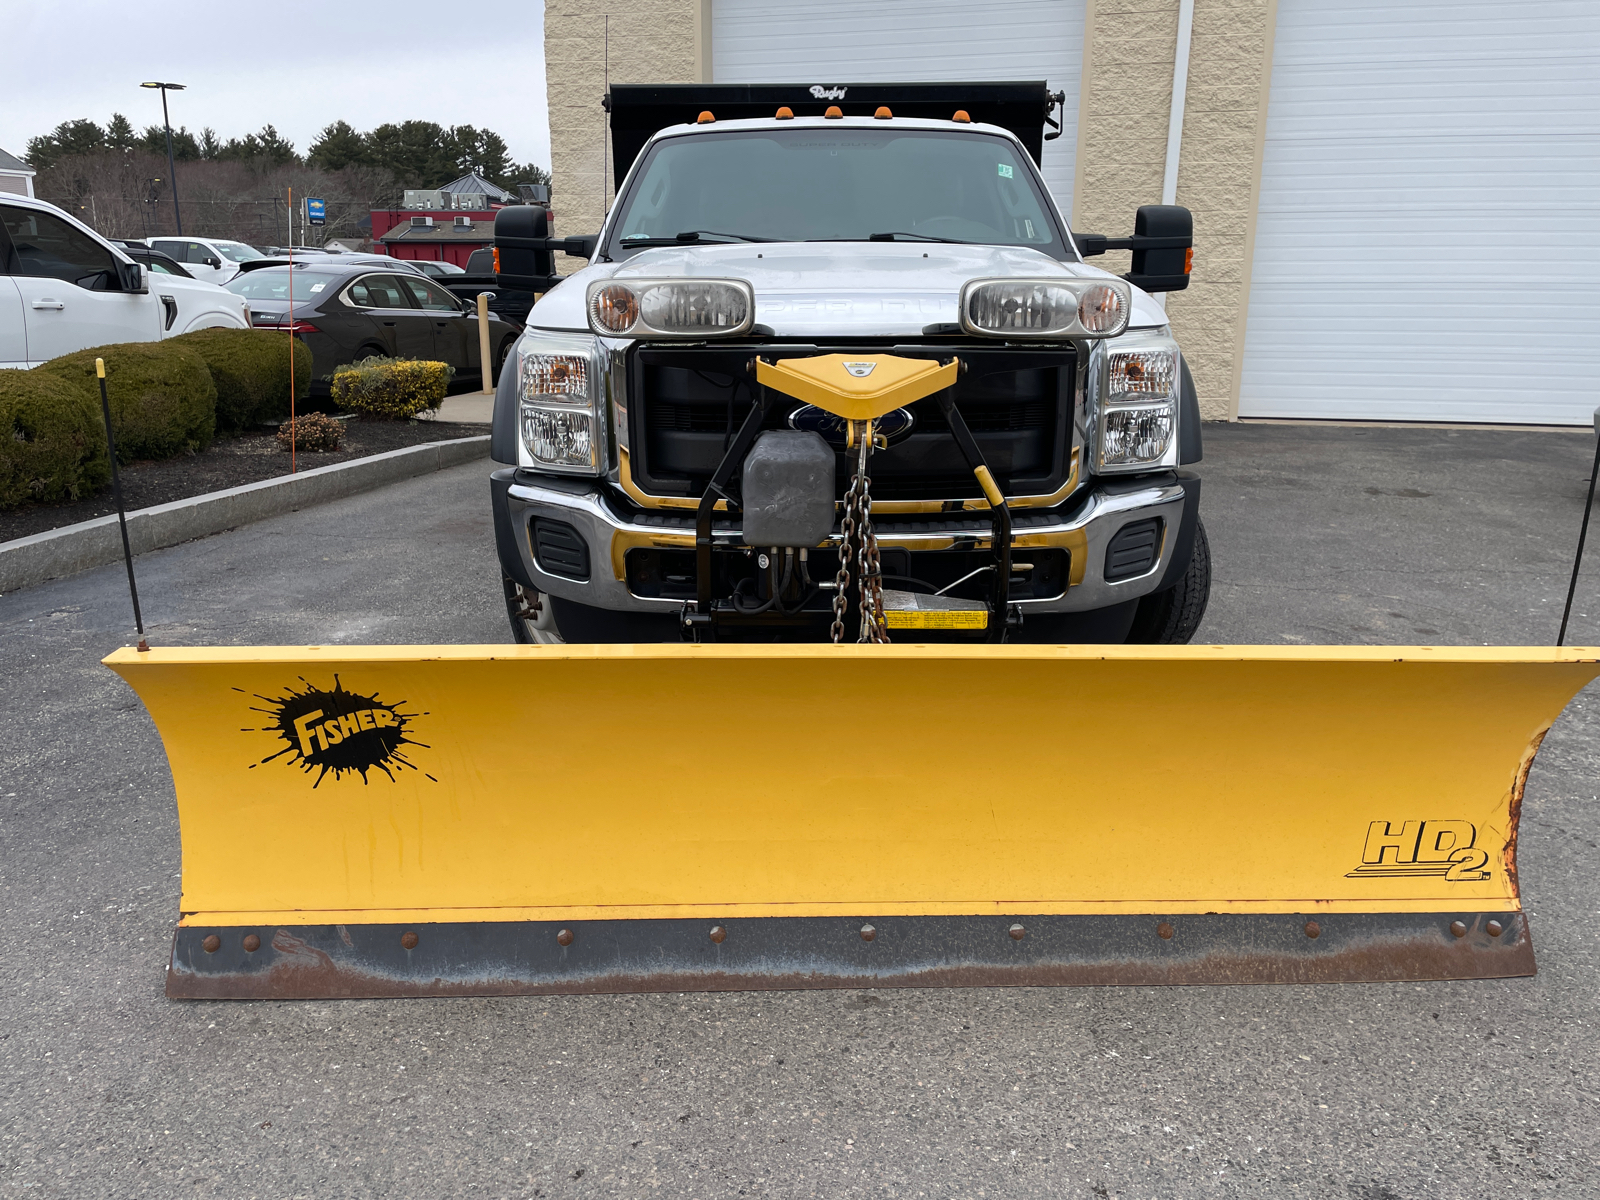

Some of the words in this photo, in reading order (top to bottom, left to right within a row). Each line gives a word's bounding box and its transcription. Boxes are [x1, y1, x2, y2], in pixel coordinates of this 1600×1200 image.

[809, 85, 845, 100] Rugby
[757, 299, 854, 315] PER
[294, 708, 400, 757] FISHER
